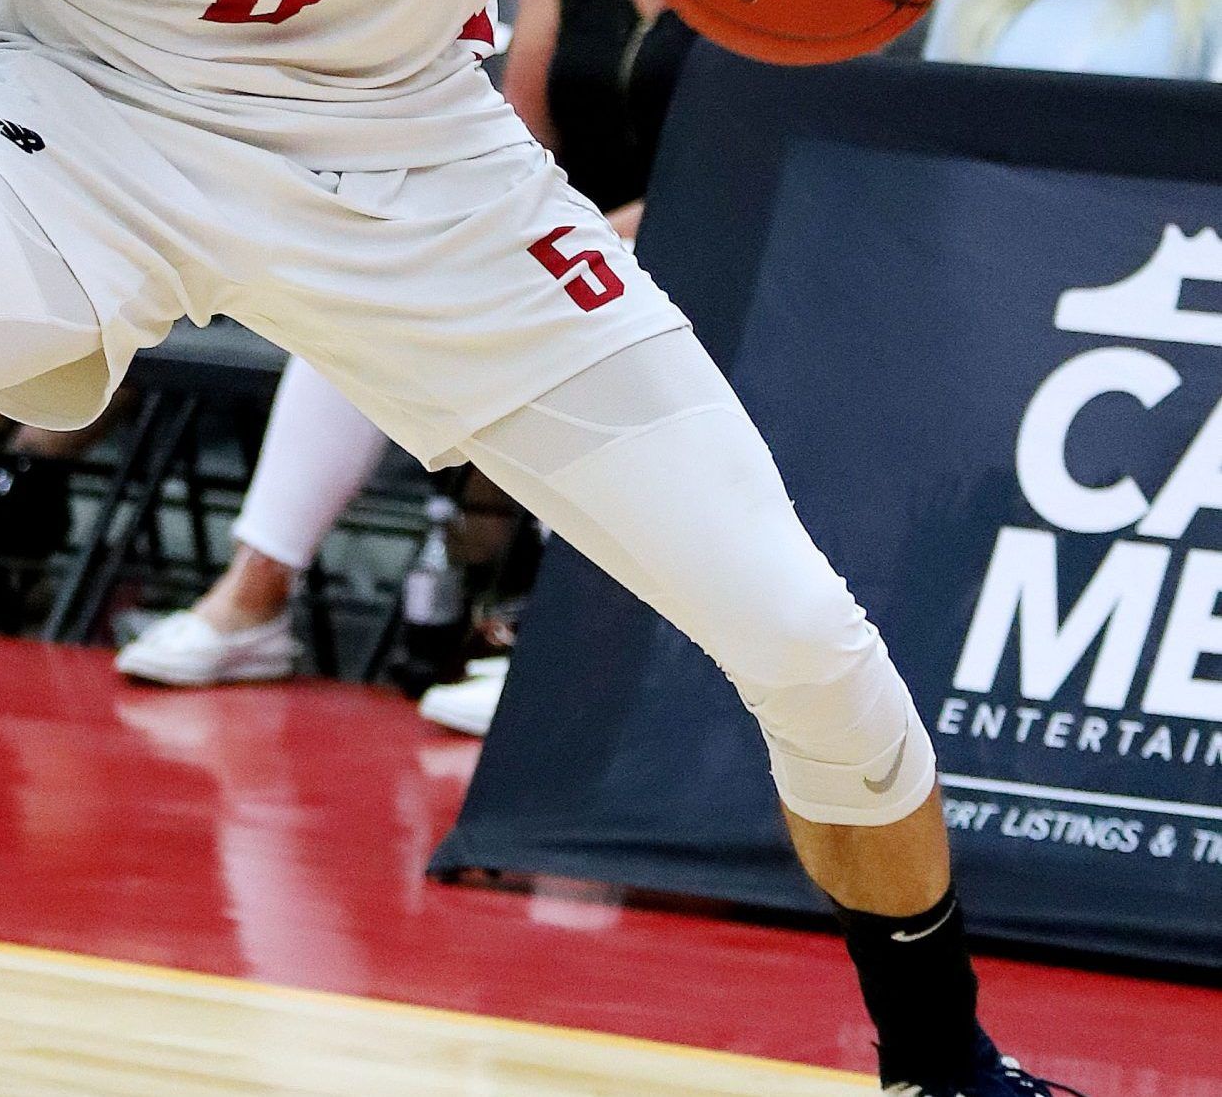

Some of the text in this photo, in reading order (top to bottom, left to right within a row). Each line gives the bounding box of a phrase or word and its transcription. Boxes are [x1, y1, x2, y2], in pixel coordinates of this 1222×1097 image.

[526, 225, 625, 313] 5
[1001, 806, 1144, 854] LISTINGS
[1149, 824, 1178, 858] &
[1193, 828, 1222, 865] TI
